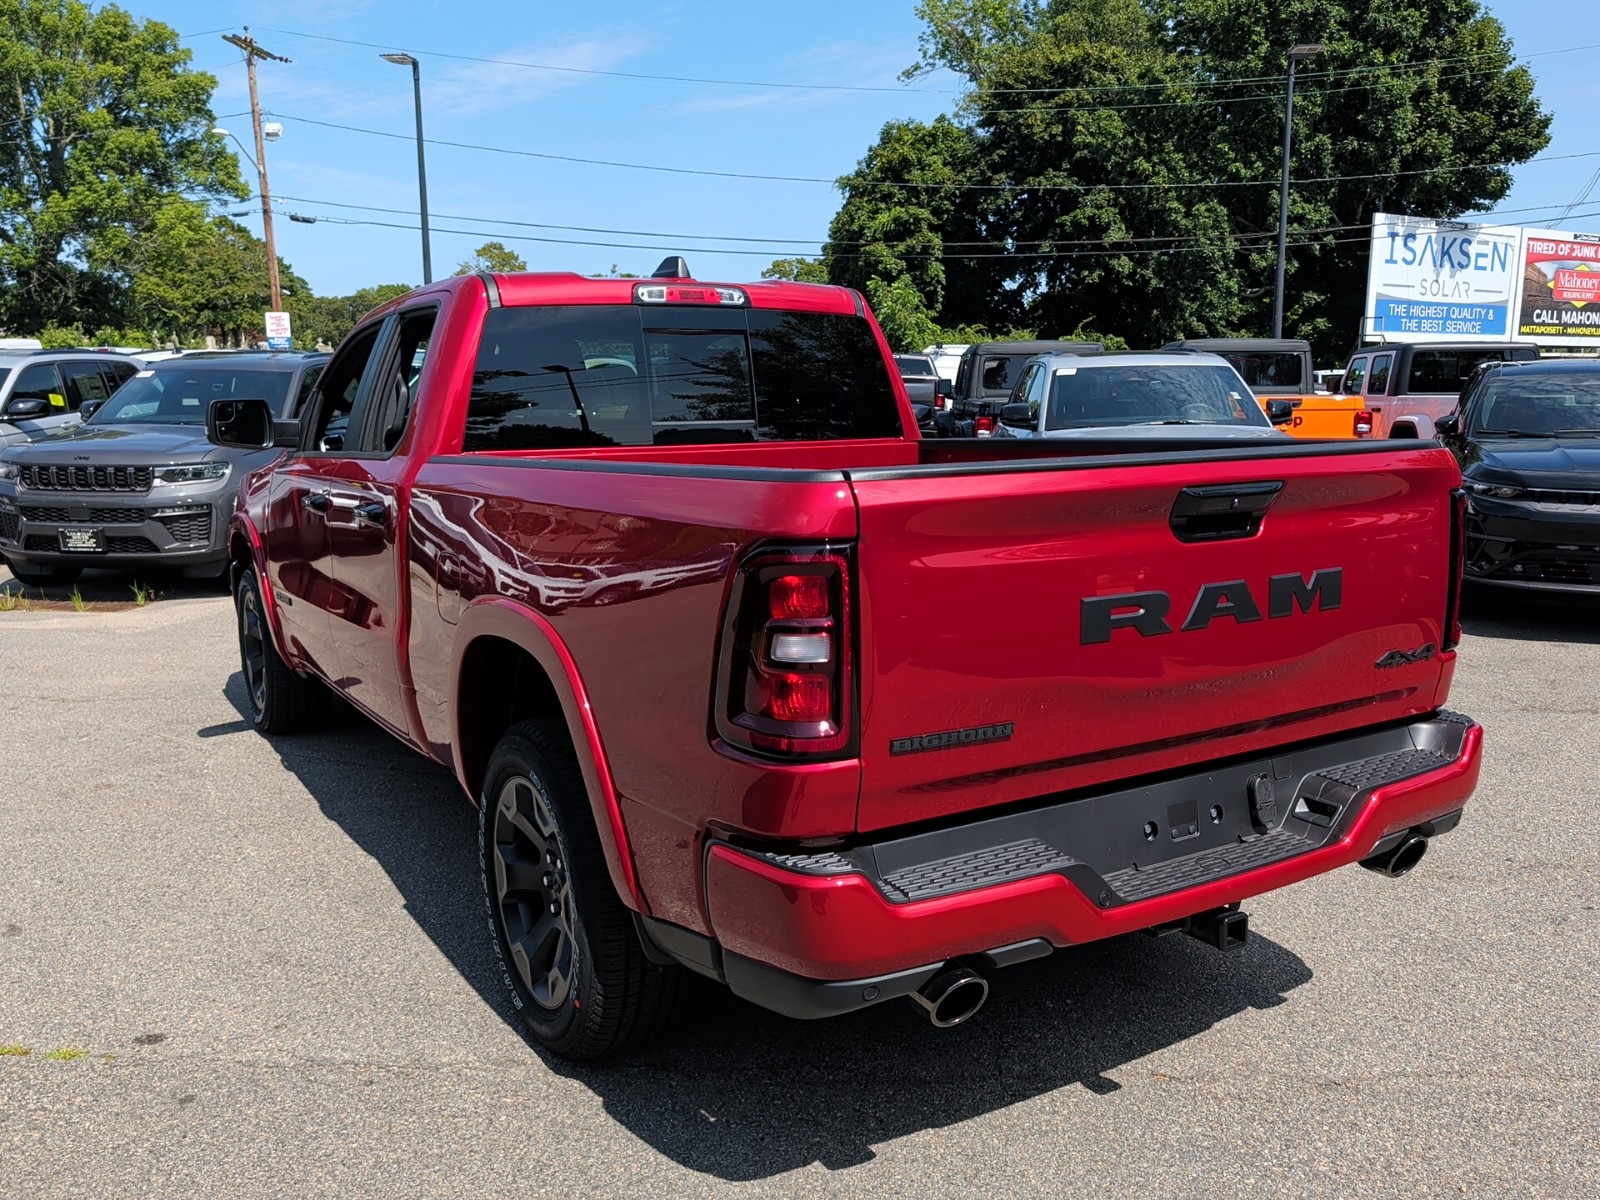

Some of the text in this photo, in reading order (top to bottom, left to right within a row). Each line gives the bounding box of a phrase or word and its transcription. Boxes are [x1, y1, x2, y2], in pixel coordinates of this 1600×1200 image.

[1384, 231, 1508, 273] ISAKSEN
[1528, 241, 1556, 255] TIRED
[1558, 244, 1571, 256] OF
[1572, 245, 1596, 258] JUNK
[1419, 278, 1470, 298] SOLAR
[1389, 304, 1494, 320] THE HIGHEST QUALITY &
[1533, 309, 1600, 325] CALL MAHON
[1401, 319, 1482, 333] THE BEST SERVICE
[1520, 325, 1563, 335] MATTAPOISETT
[1080, 567, 1343, 645] RAM
[890, 722, 1014, 756] BIGHORN
